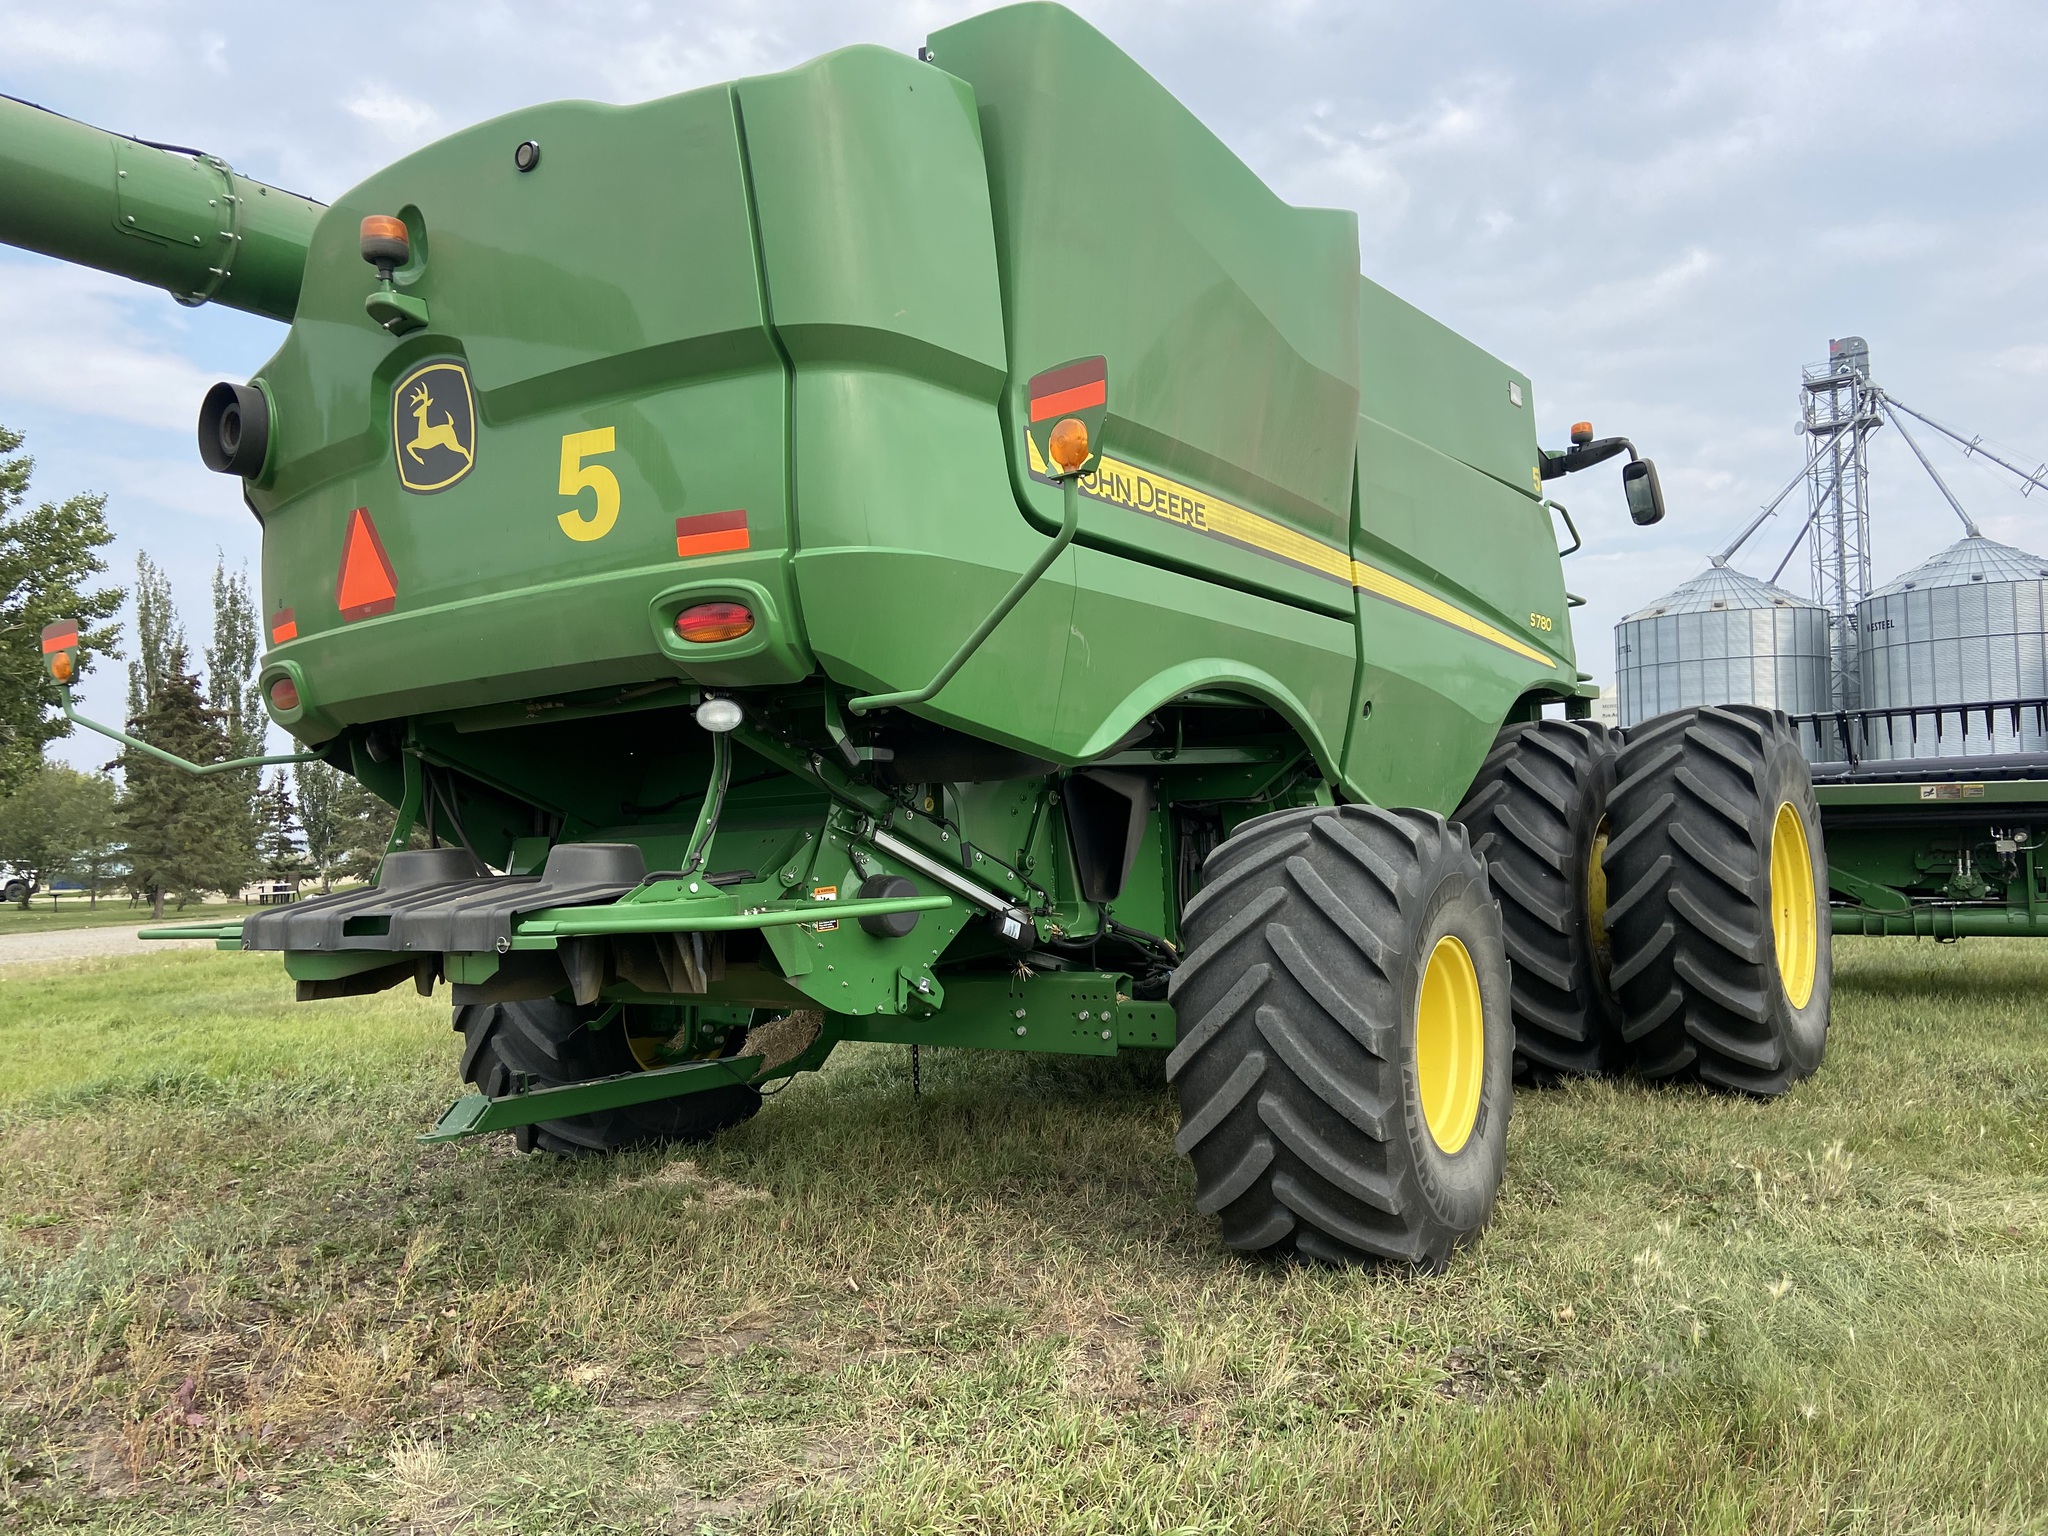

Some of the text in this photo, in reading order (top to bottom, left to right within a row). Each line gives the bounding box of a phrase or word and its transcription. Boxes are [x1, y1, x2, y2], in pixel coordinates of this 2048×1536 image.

[557, 426, 621, 542] 5
[1080, 468, 1207, 527] OHN DEERE
[1530, 612, 1552, 632] S780
